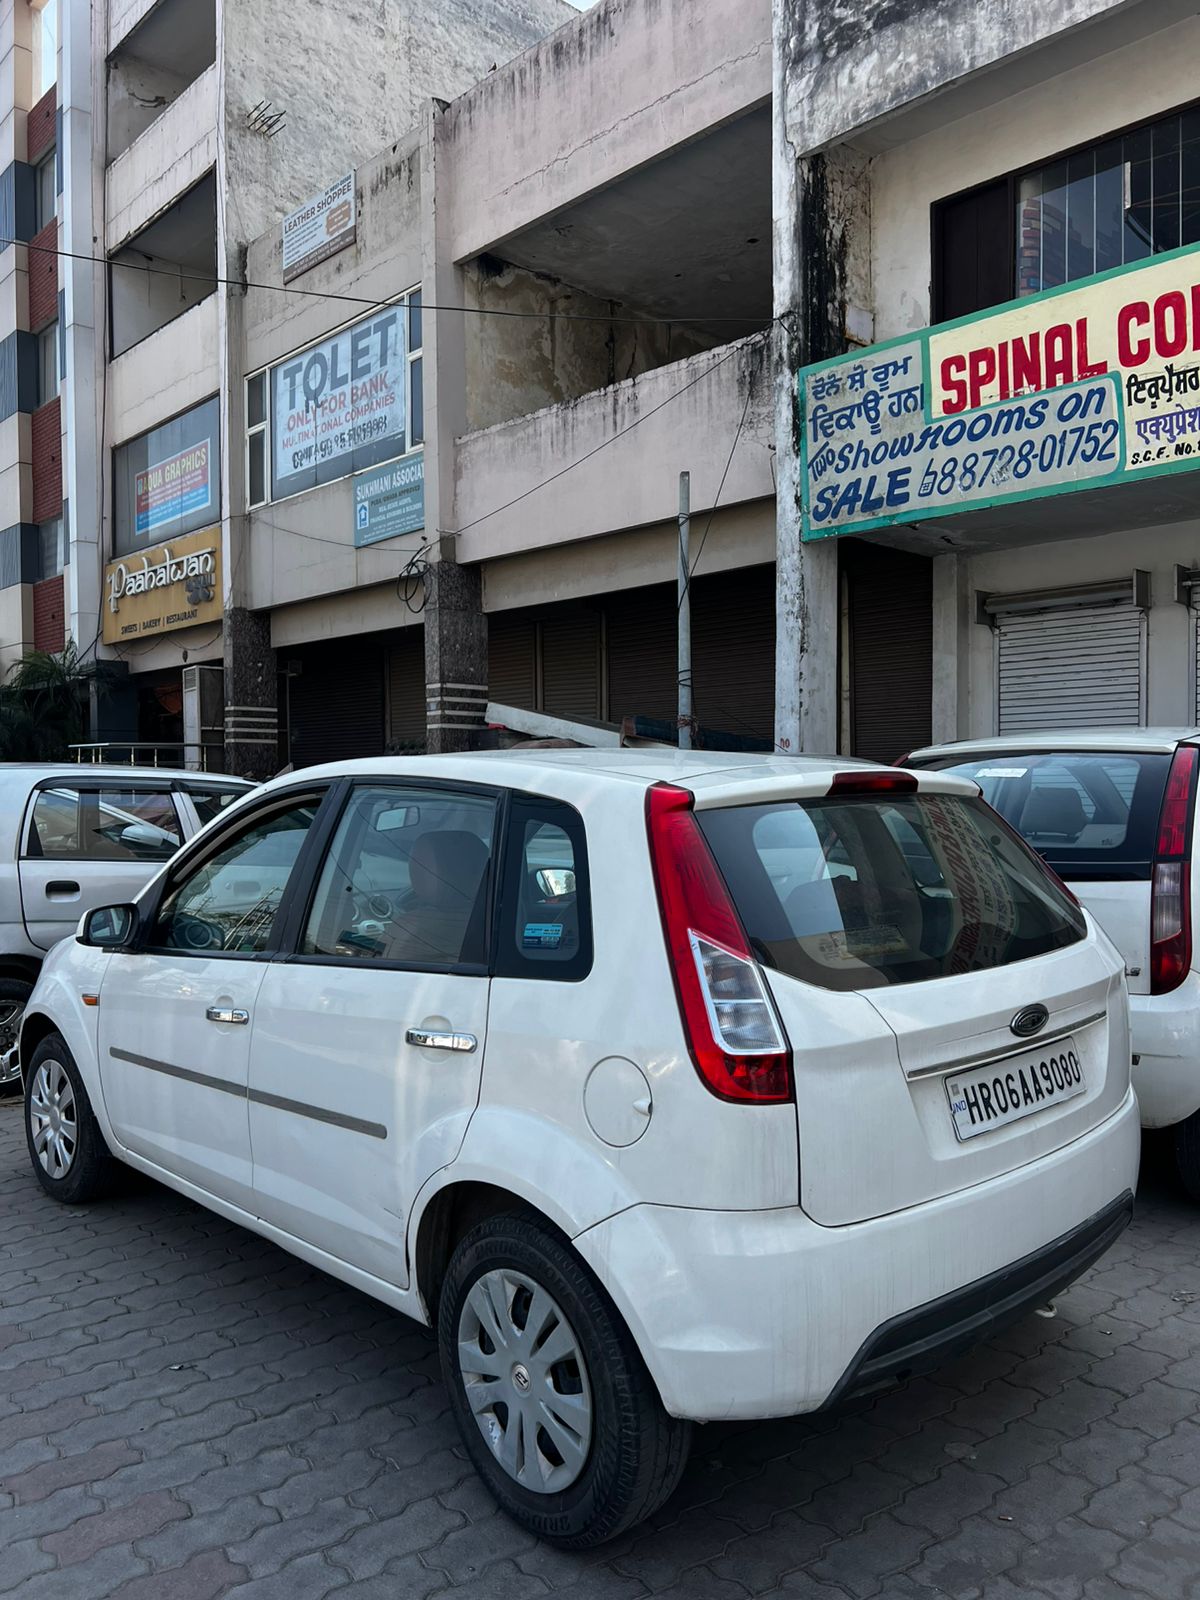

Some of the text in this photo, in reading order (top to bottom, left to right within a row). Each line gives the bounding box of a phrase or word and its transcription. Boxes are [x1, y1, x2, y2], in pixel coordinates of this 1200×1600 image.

[284, 205, 316, 235] LEATHER
[317, 181, 352, 213] SHOPPEE
[941, 317, 1108, 414] SPINAL
[287, 404, 320, 432] ONLY
[321, 391, 346, 417] FOR
[351, 371, 389, 404] BANK
[345, 392, 395, 421] COMPANIES
[1057, 386, 1106, 422] on
[164, 447, 206, 483] GRAPHICS
[1131, 446, 1170, 465] S.C.F.
[357, 474, 391, 501] SUKHMANI
[812, 466, 912, 522] SALE
[107, 548, 215, 613] Paahalwan
[121, 609, 198, 635] SWEETS BAKERY RESTAURANT
[964, 1051, 1081, 1124] HR06AA9080
